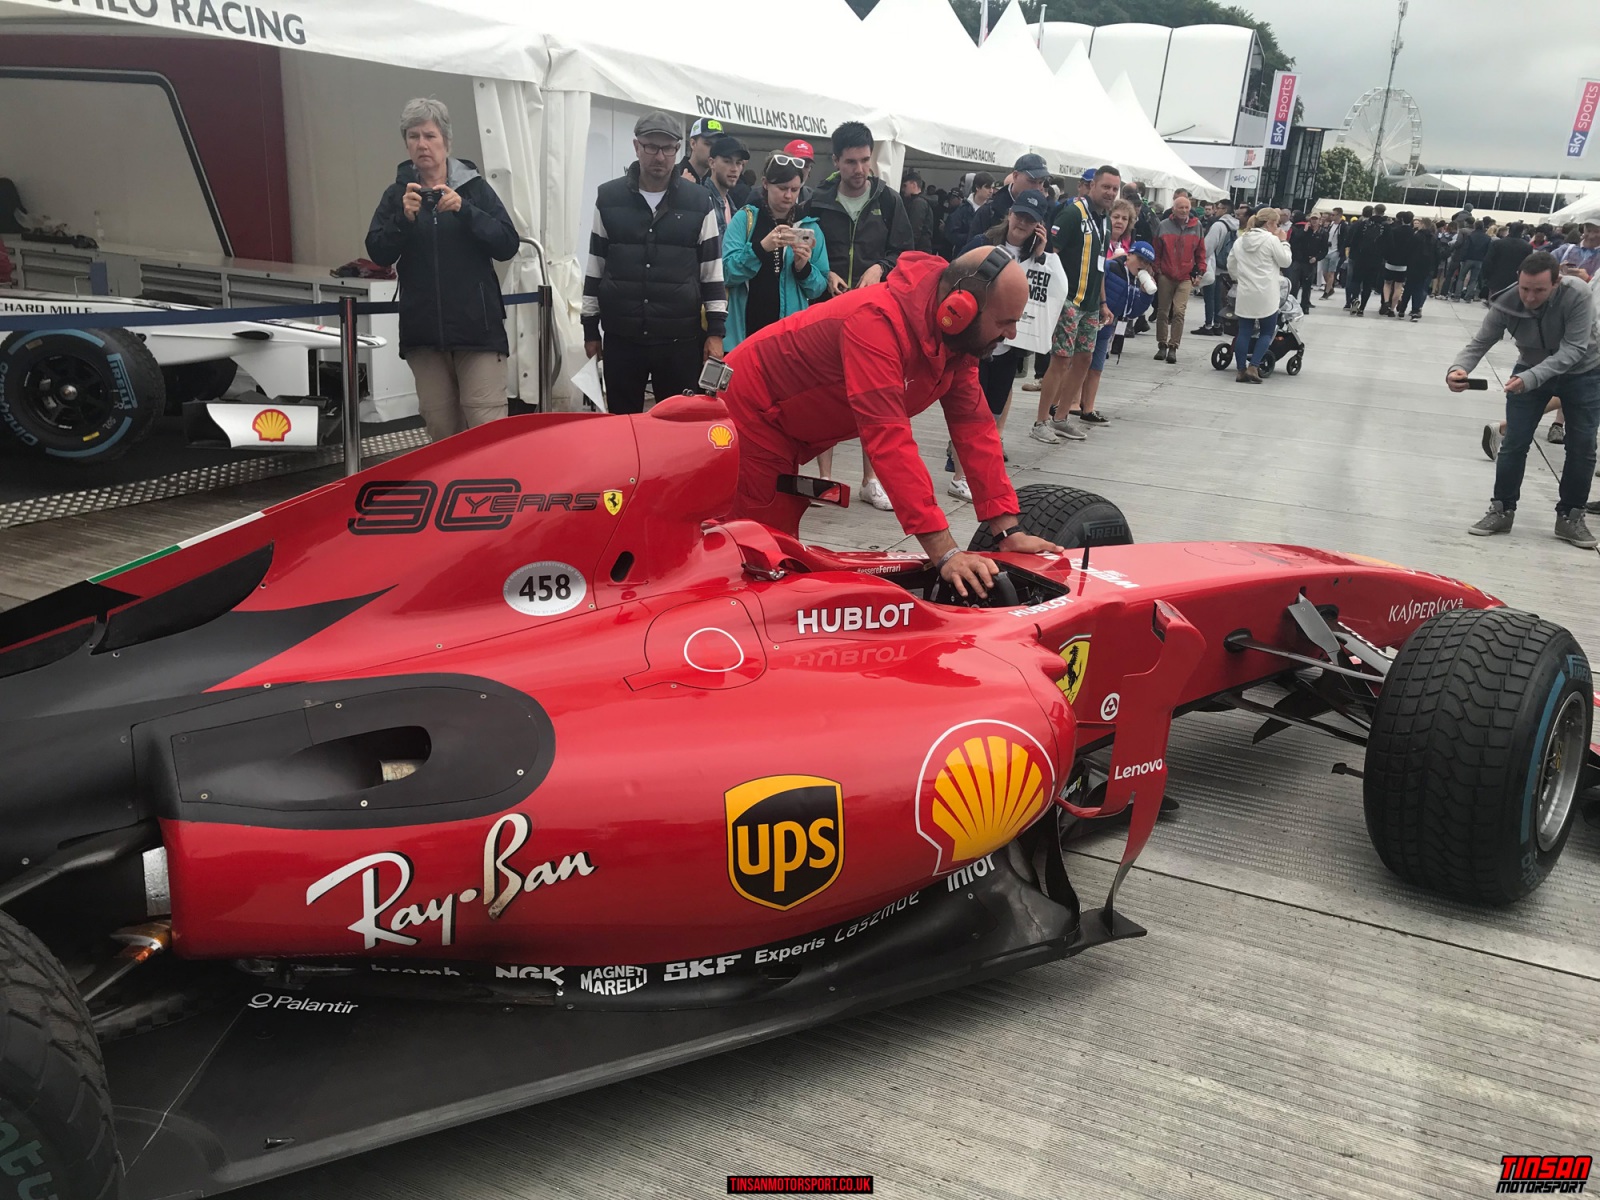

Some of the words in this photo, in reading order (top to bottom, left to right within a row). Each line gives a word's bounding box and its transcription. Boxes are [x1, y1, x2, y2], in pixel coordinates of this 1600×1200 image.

[171, 0, 307, 45] RACING
[1278, 78, 1293, 119] sports
[734, 103, 788, 129] WILLIAMS
[789, 113, 828, 135] RACING
[1273, 122, 1286, 143] sky
[1569, 132, 1586, 154] sky
[1578, 85, 1599, 129] sports
[978, 148, 996, 164] RACING
[1026, 269, 1052, 288] PEED
[0, 302, 45, 313] HARD
[1028, 285, 1048, 303] NGS
[464, 492, 601, 514] YEARS
[518, 573, 572, 602] 458
[797, 602, 915, 635] HUBLOT
[1388, 597, 1457, 624] KASPERSKY
[1114, 758, 1163, 780] Lenovo
[735, 816, 837, 892] ups
[755, 936, 825, 965] Experis
[495, 965, 566, 987] NGK
[663, 954, 742, 982] SKF
[273, 995, 359, 1015] Palantir
